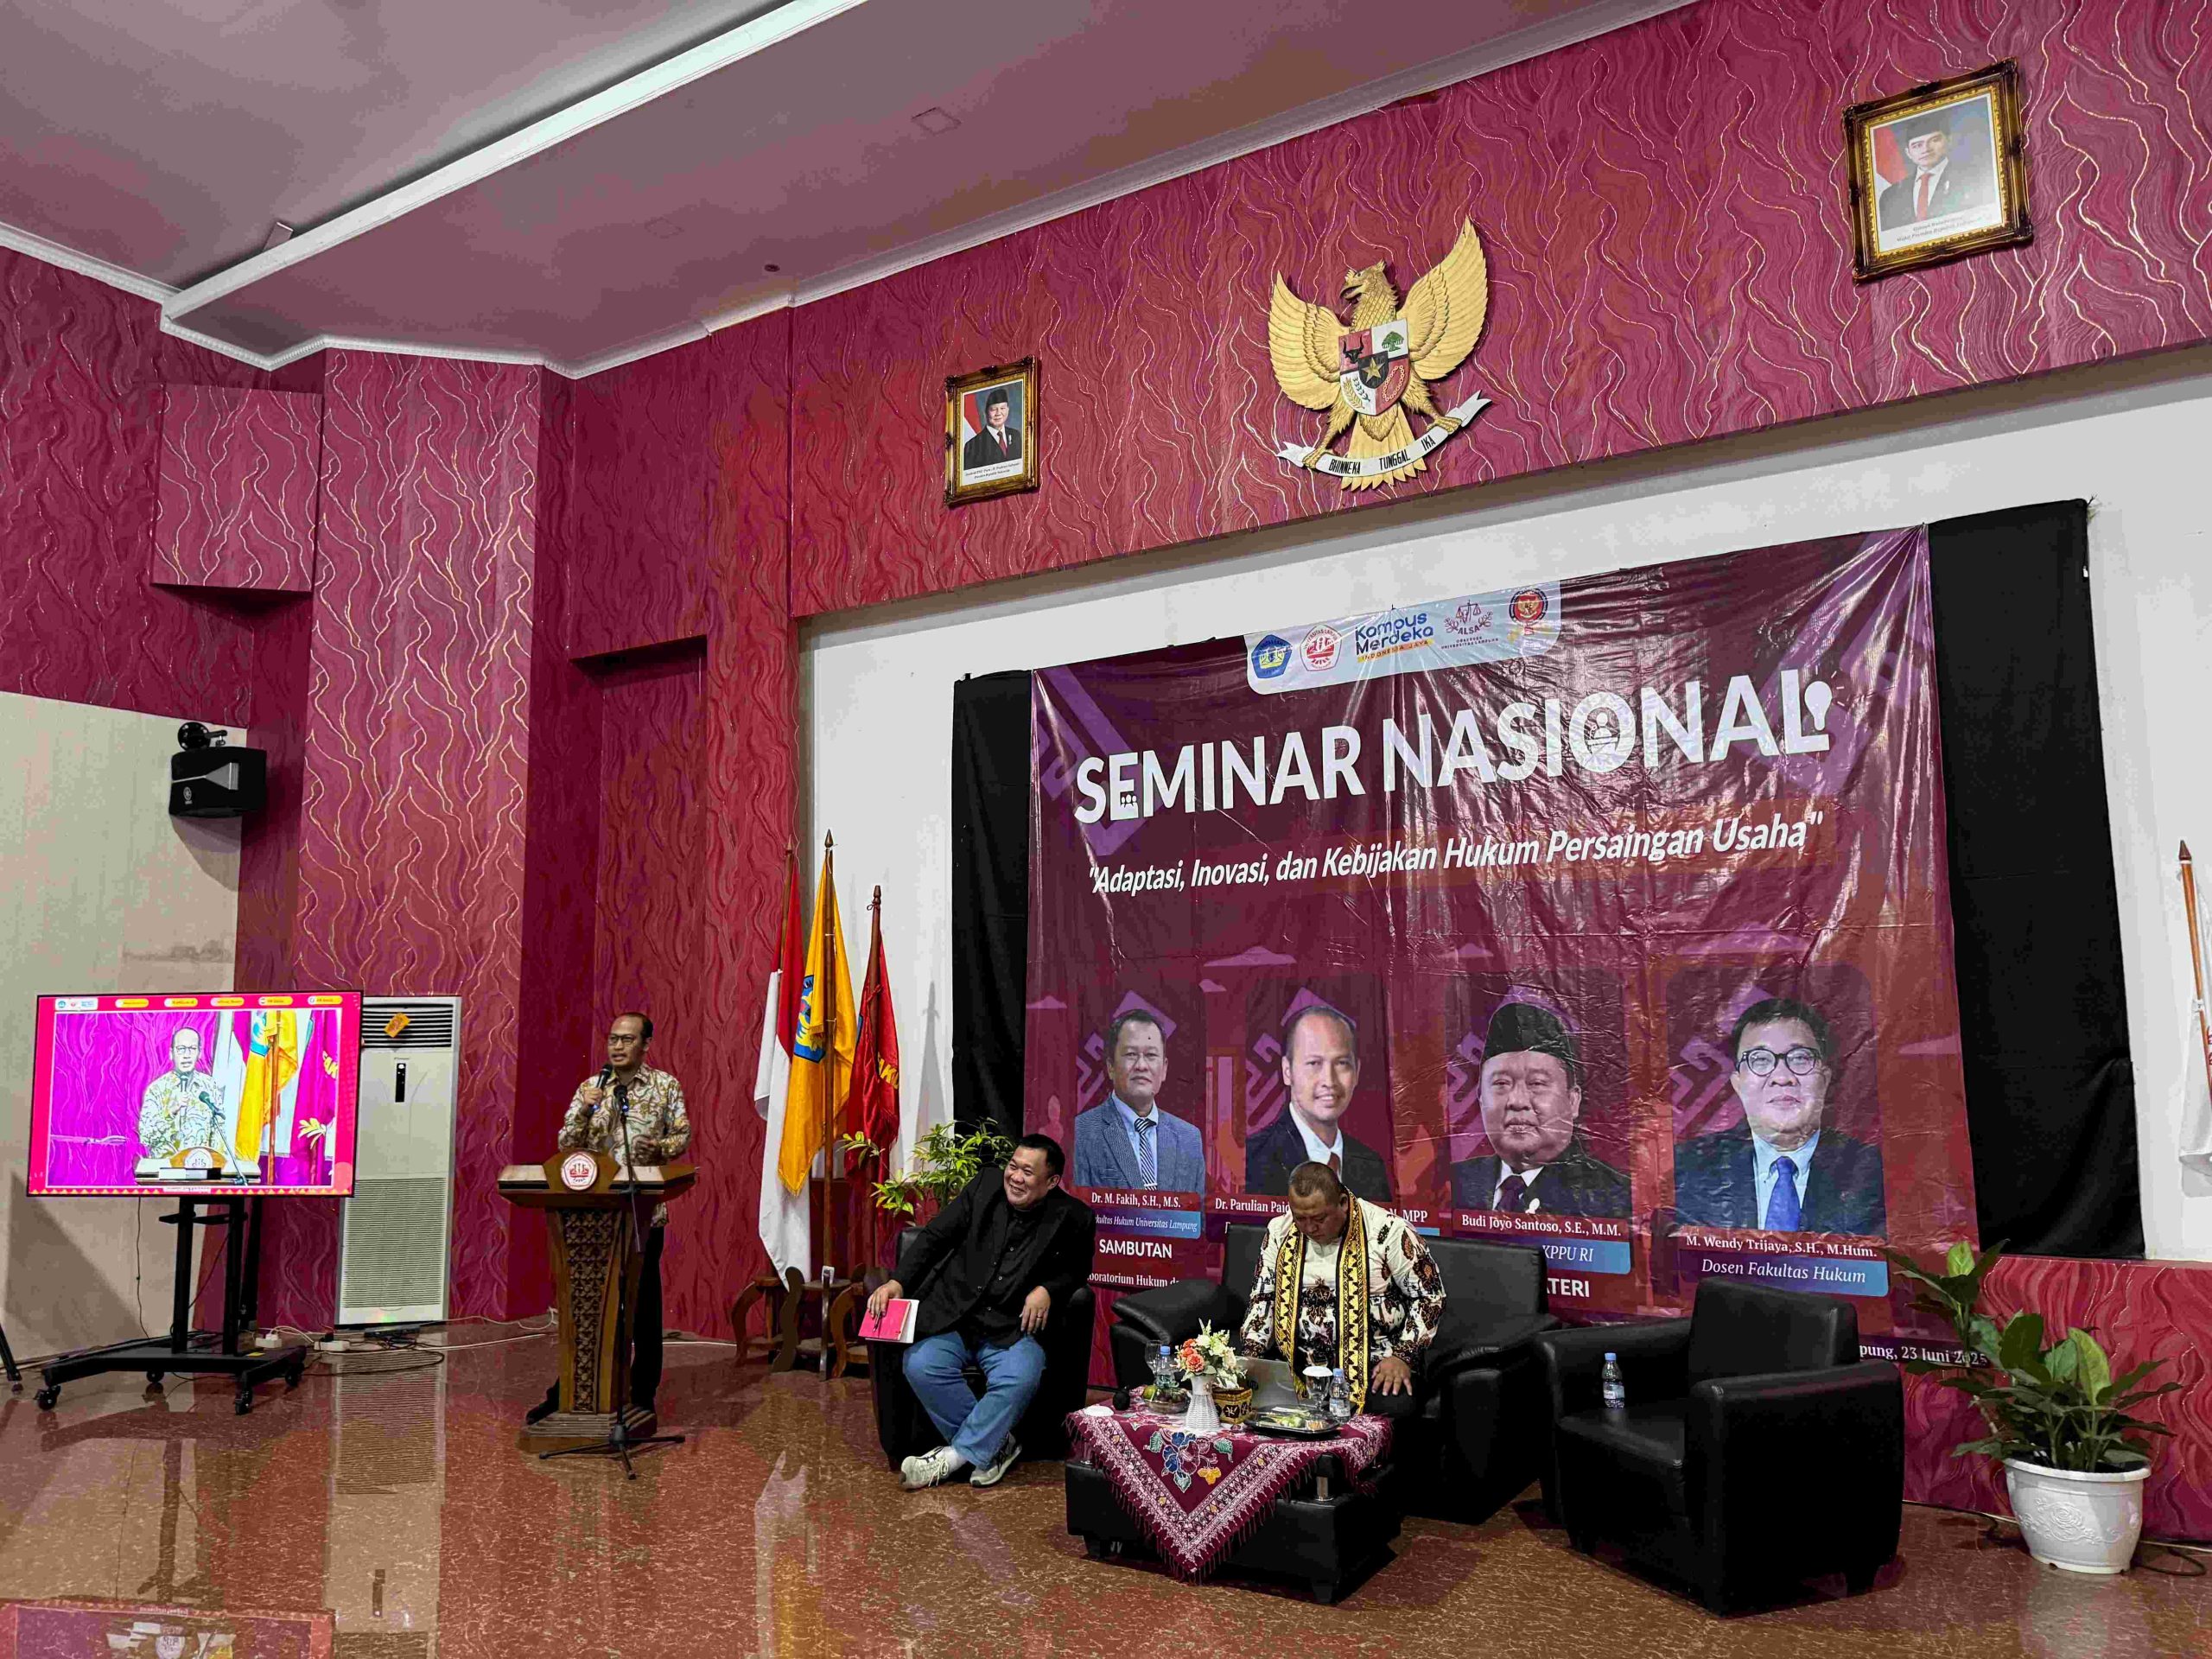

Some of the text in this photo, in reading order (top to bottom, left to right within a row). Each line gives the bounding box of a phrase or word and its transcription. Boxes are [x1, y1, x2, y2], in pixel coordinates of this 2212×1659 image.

[1328, 434, 1437, 474] BHINNEKA TUNGGAL IKA
[1355, 613, 1427, 641] Kampus
[1457, 625, 1480, 635] ALSA
[1356, 626, 1434, 655] Merdeka
[1408, 639, 1428, 649] JAYA
[1074, 669, 1830, 824] SEMINAR NASIONAL
[1089, 811, 1824, 896] "Adaptasi, Inovasi, dan Kebijakan Hukum Persaingan Usaha"
[1091, 1192, 1181, 1208] Dr. M. Fakih, S.H., M.S.
[1215, 1198, 1290, 1213] Dr. Parulian Paid
[1096, 1214, 1198, 1232] kultas Hukum Universitas Lampung
[1402, 1210, 1427, 1223] MPP
[1462, 1214, 1622, 1236] Budi Joyo Santoso, S.E., M.M.
[1099, 1238, 1173, 1259] SAMBUTAN
[1541, 1244, 1594, 1262] KPPU RI
[1686, 1235, 1878, 1257] M. Wendy Trijaya, S.H., M.Hum.
[1136, 1274, 1168, 1287] Hukum
[1701, 1259, 1866, 1282] Dosen Fakultas Hukum
[1546, 1277, 1590, 1298] TERI
[1859, 1344, 1898, 1360] pung,
[1901, 1346, 1918, 1359] 23
